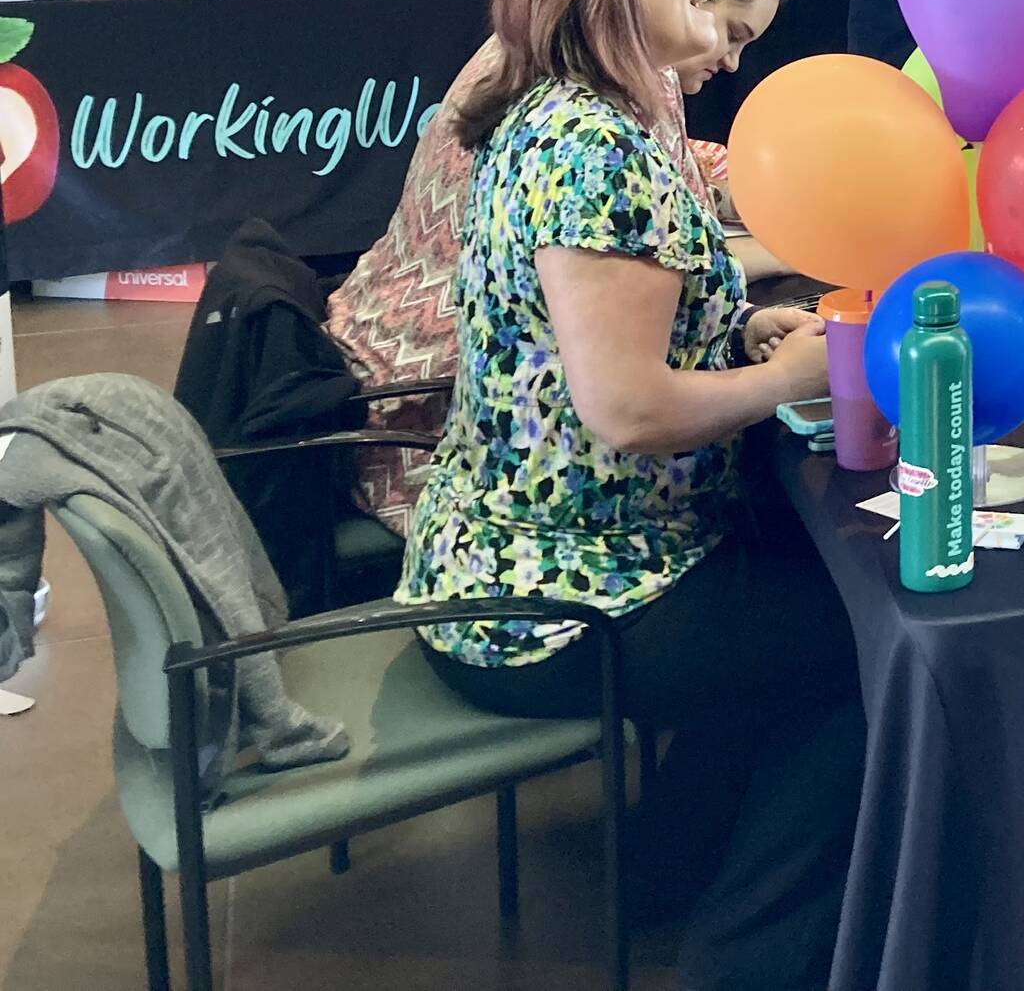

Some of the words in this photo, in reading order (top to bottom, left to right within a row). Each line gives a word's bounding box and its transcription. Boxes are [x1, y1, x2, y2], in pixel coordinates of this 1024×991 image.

[118, 270, 189, 287] universal
[948, 380, 963, 439] count
[946, 443, 966, 501] today
[946, 503, 963, 558] Make
